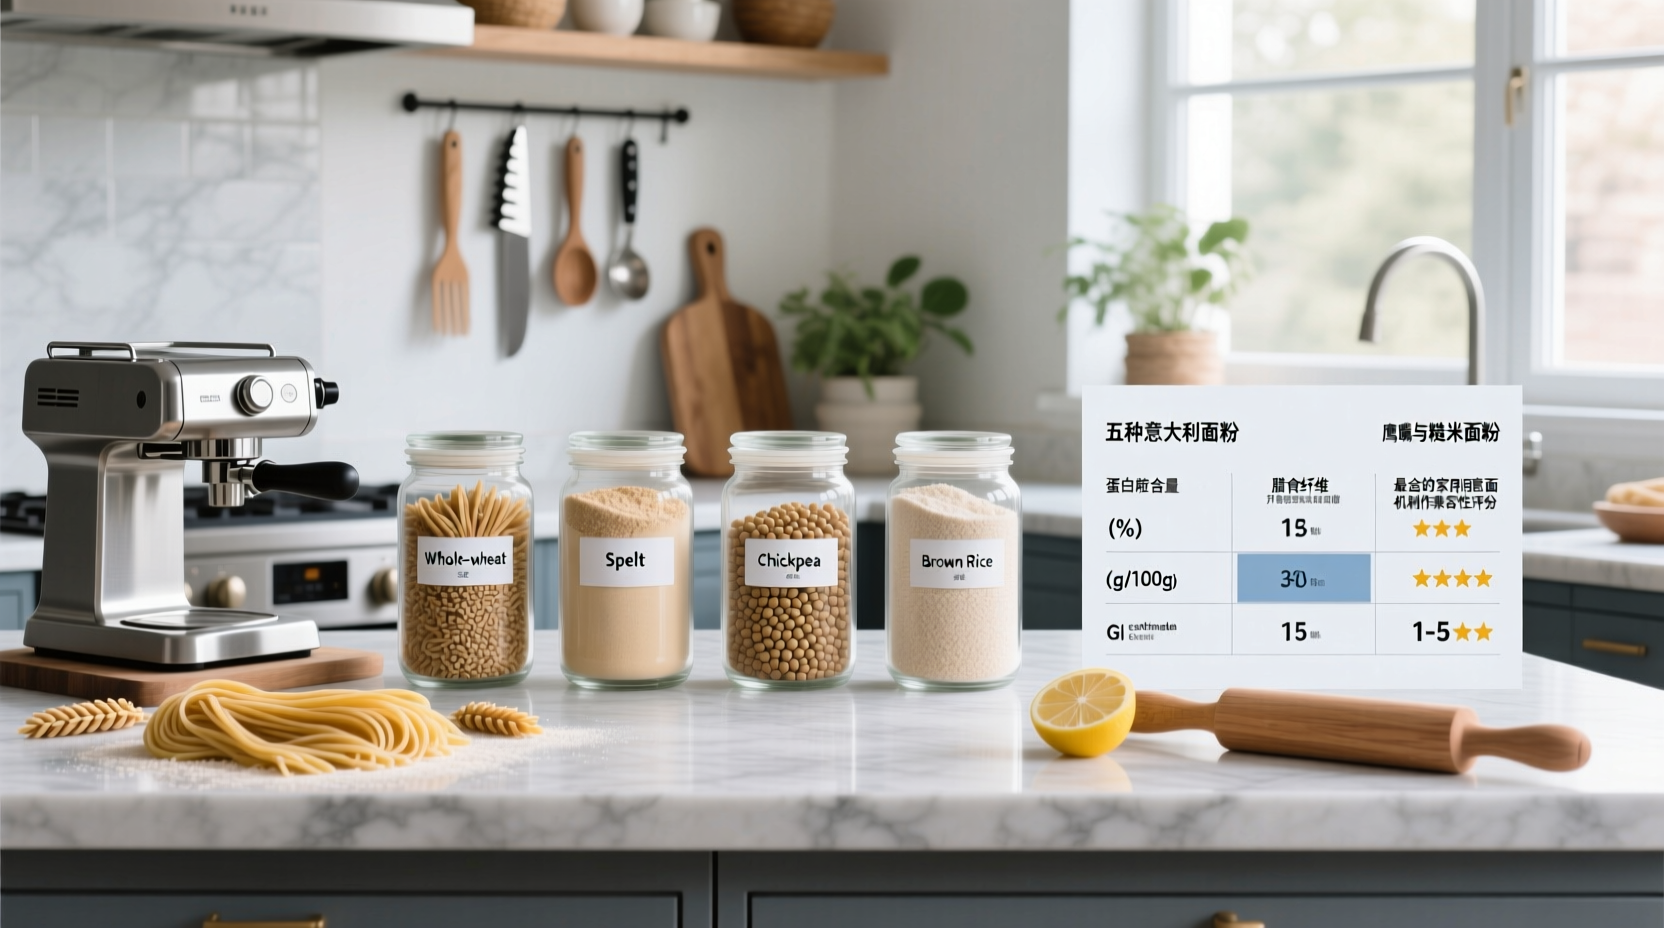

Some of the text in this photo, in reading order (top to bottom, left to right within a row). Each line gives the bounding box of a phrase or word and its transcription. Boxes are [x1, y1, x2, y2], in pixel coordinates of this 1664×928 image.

[1105, 421, 1240, 444] 五种意大利面粉
[1108, 518, 1142, 540] (%)
[605, 551, 646, 571] Spelt
[757, 552, 821, 572] Chickpea
[921, 554, 994, 568] Brown Rice
[1106, 570, 1178, 592] (g/100g)
[1106, 624, 1125, 641] GI
[1281, 622, 1308, 641] 15
[1412, 621, 1450, 642] 1-5
